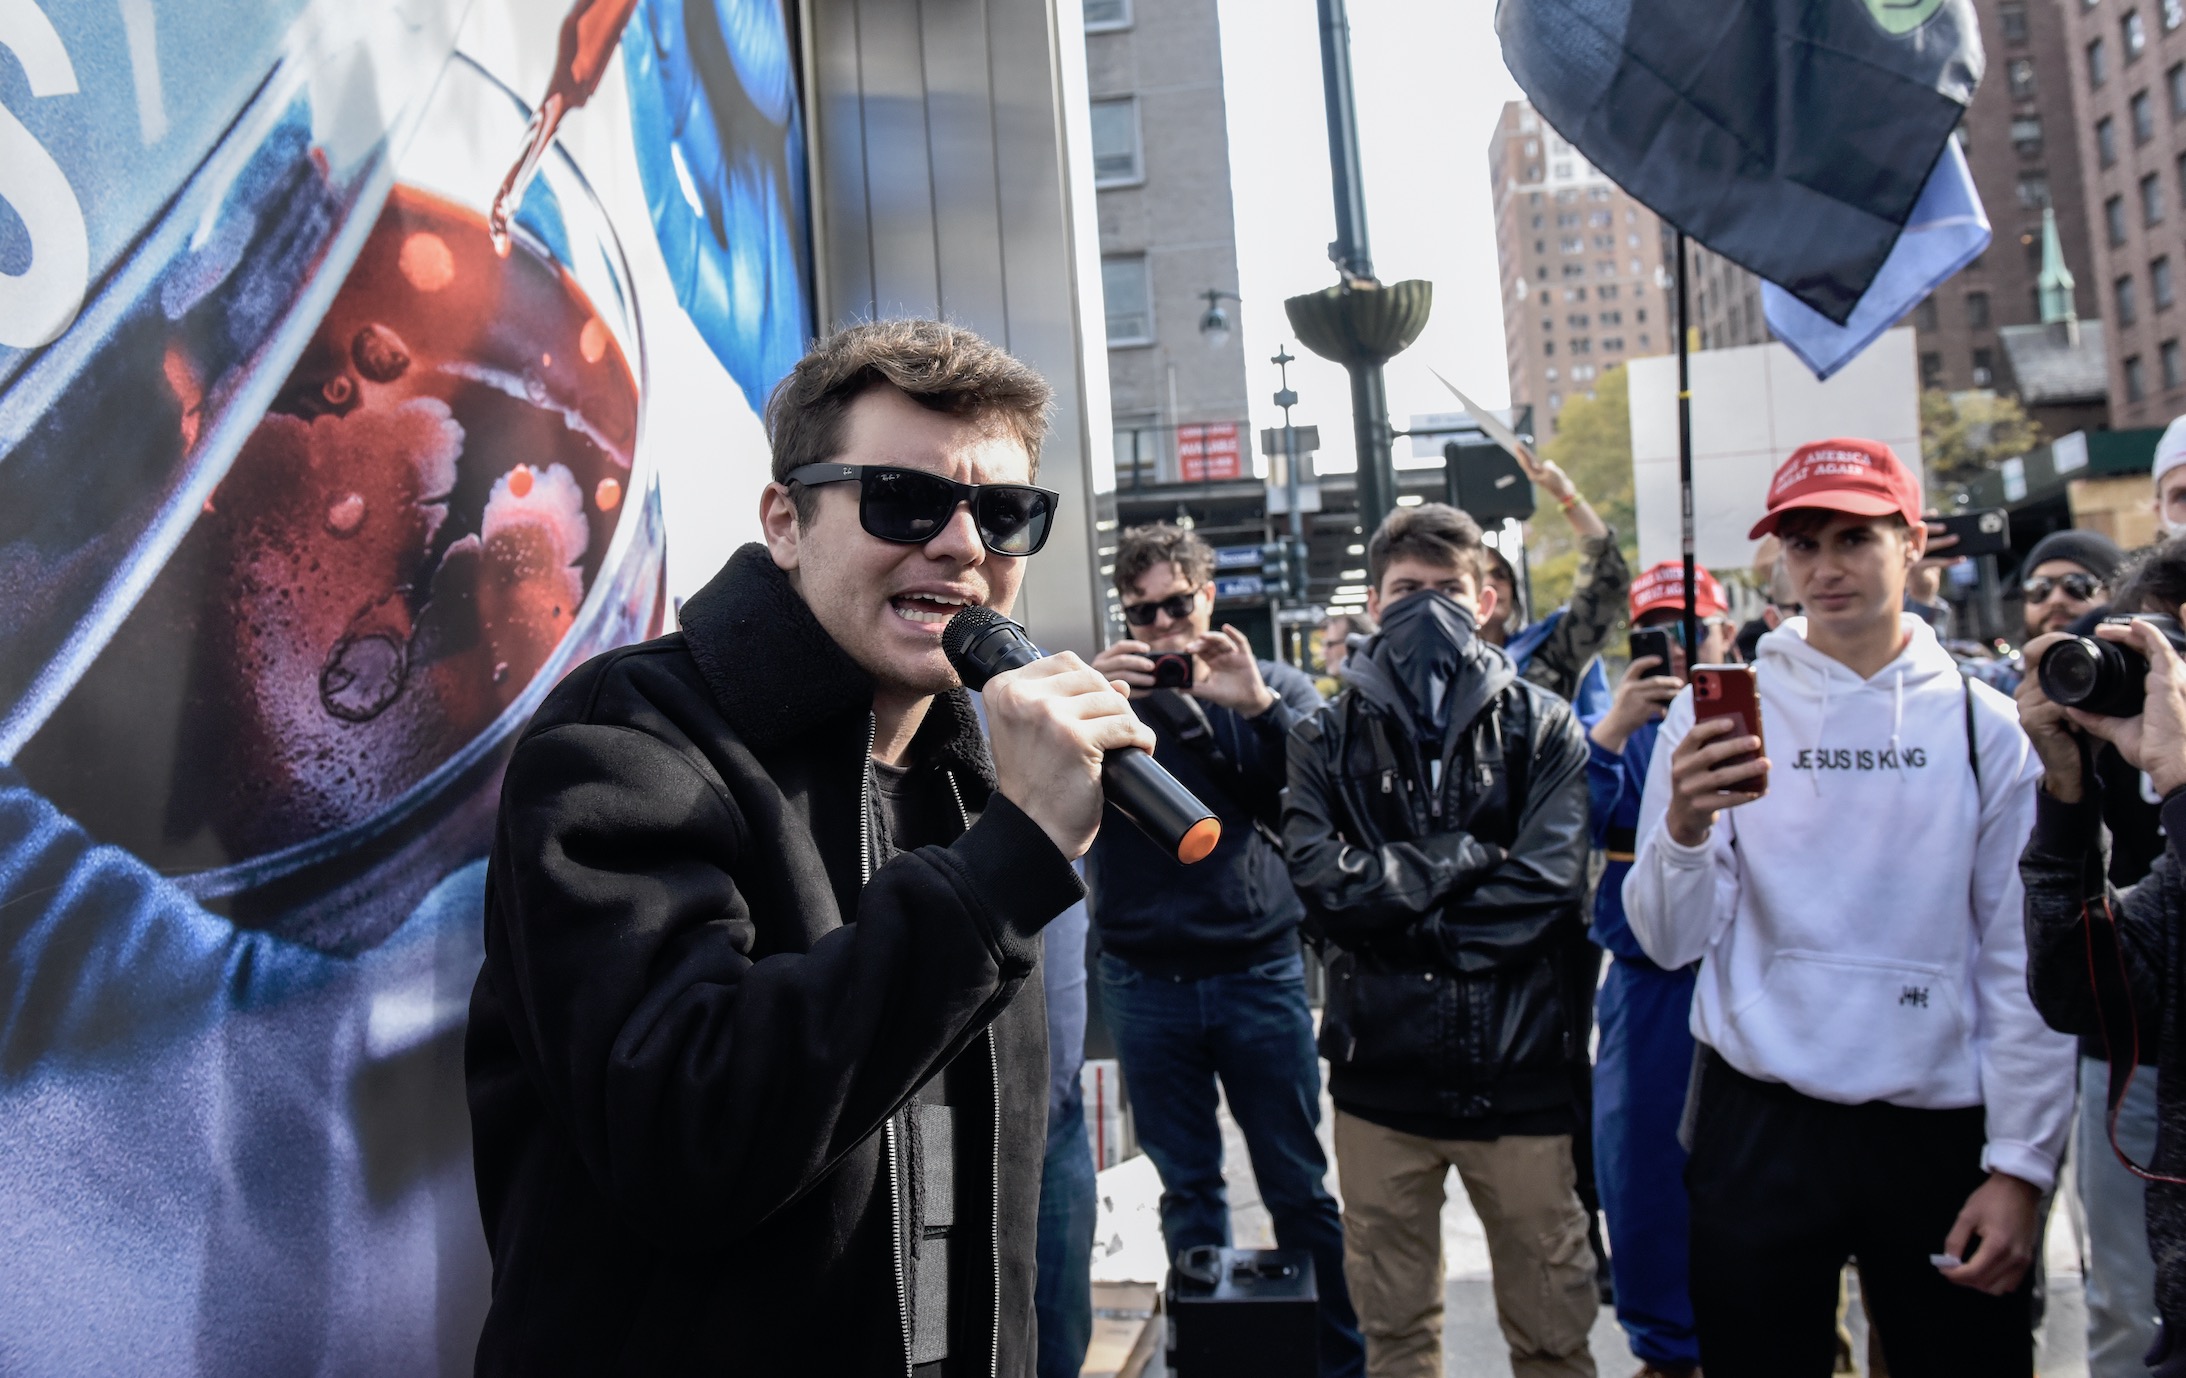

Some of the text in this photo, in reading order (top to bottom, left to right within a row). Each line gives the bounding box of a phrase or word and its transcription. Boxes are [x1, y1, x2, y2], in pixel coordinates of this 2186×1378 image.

[1804, 450, 1872, 467] AMERICA
[1813, 463, 1864, 475] AGAIN
[1792, 748, 1926, 770] JESUS IS KING
